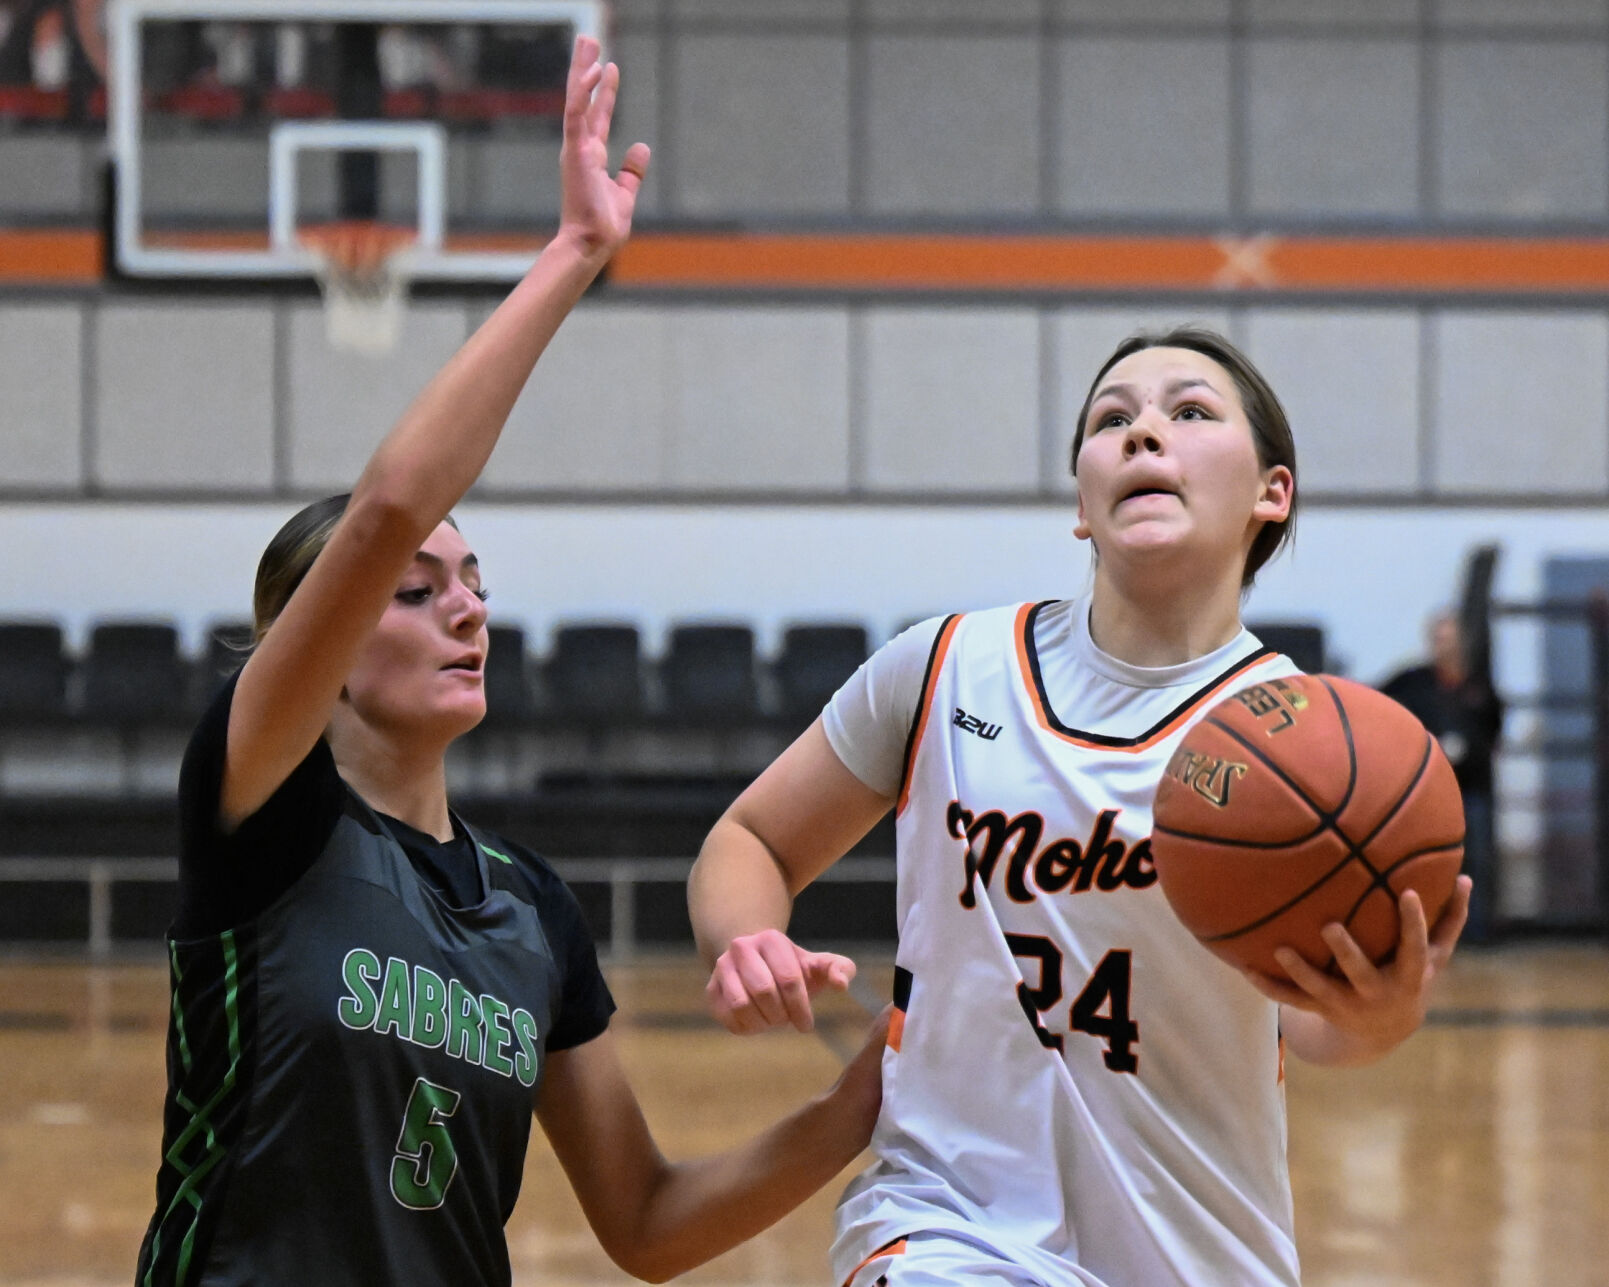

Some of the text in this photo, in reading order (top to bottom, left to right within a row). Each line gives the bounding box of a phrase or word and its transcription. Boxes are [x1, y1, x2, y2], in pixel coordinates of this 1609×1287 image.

[338, 948, 538, 1087] SABRES
[1003, 932, 1139, 1075] 24
[389, 1076, 461, 1211] 5
